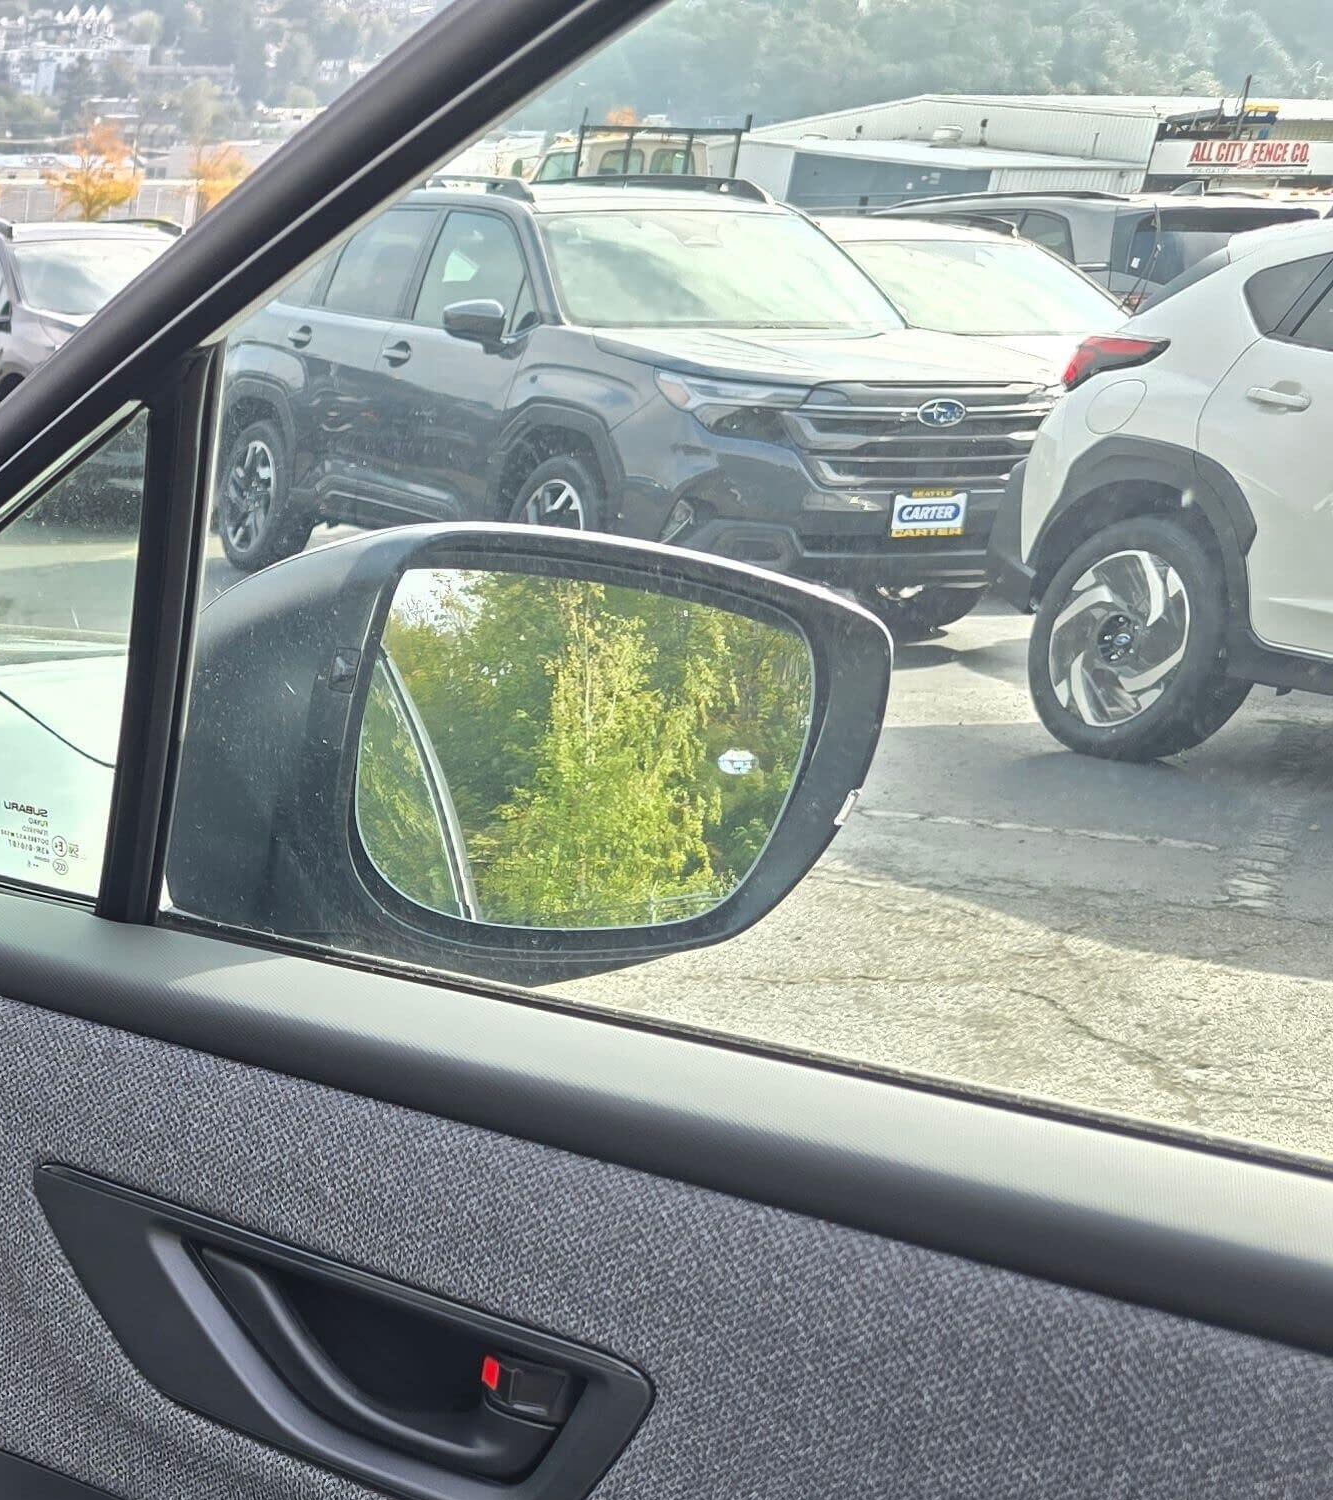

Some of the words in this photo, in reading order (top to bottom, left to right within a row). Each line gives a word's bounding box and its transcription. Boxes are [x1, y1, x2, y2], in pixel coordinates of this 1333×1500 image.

[1191, 142, 1213, 162] ALL
[1216, 142, 1248, 162] CITY
[1250, 142, 1290, 162] FENCE
[1290, 143, 1310, 163] CO.
[901, 505, 956, 521] CARTER
